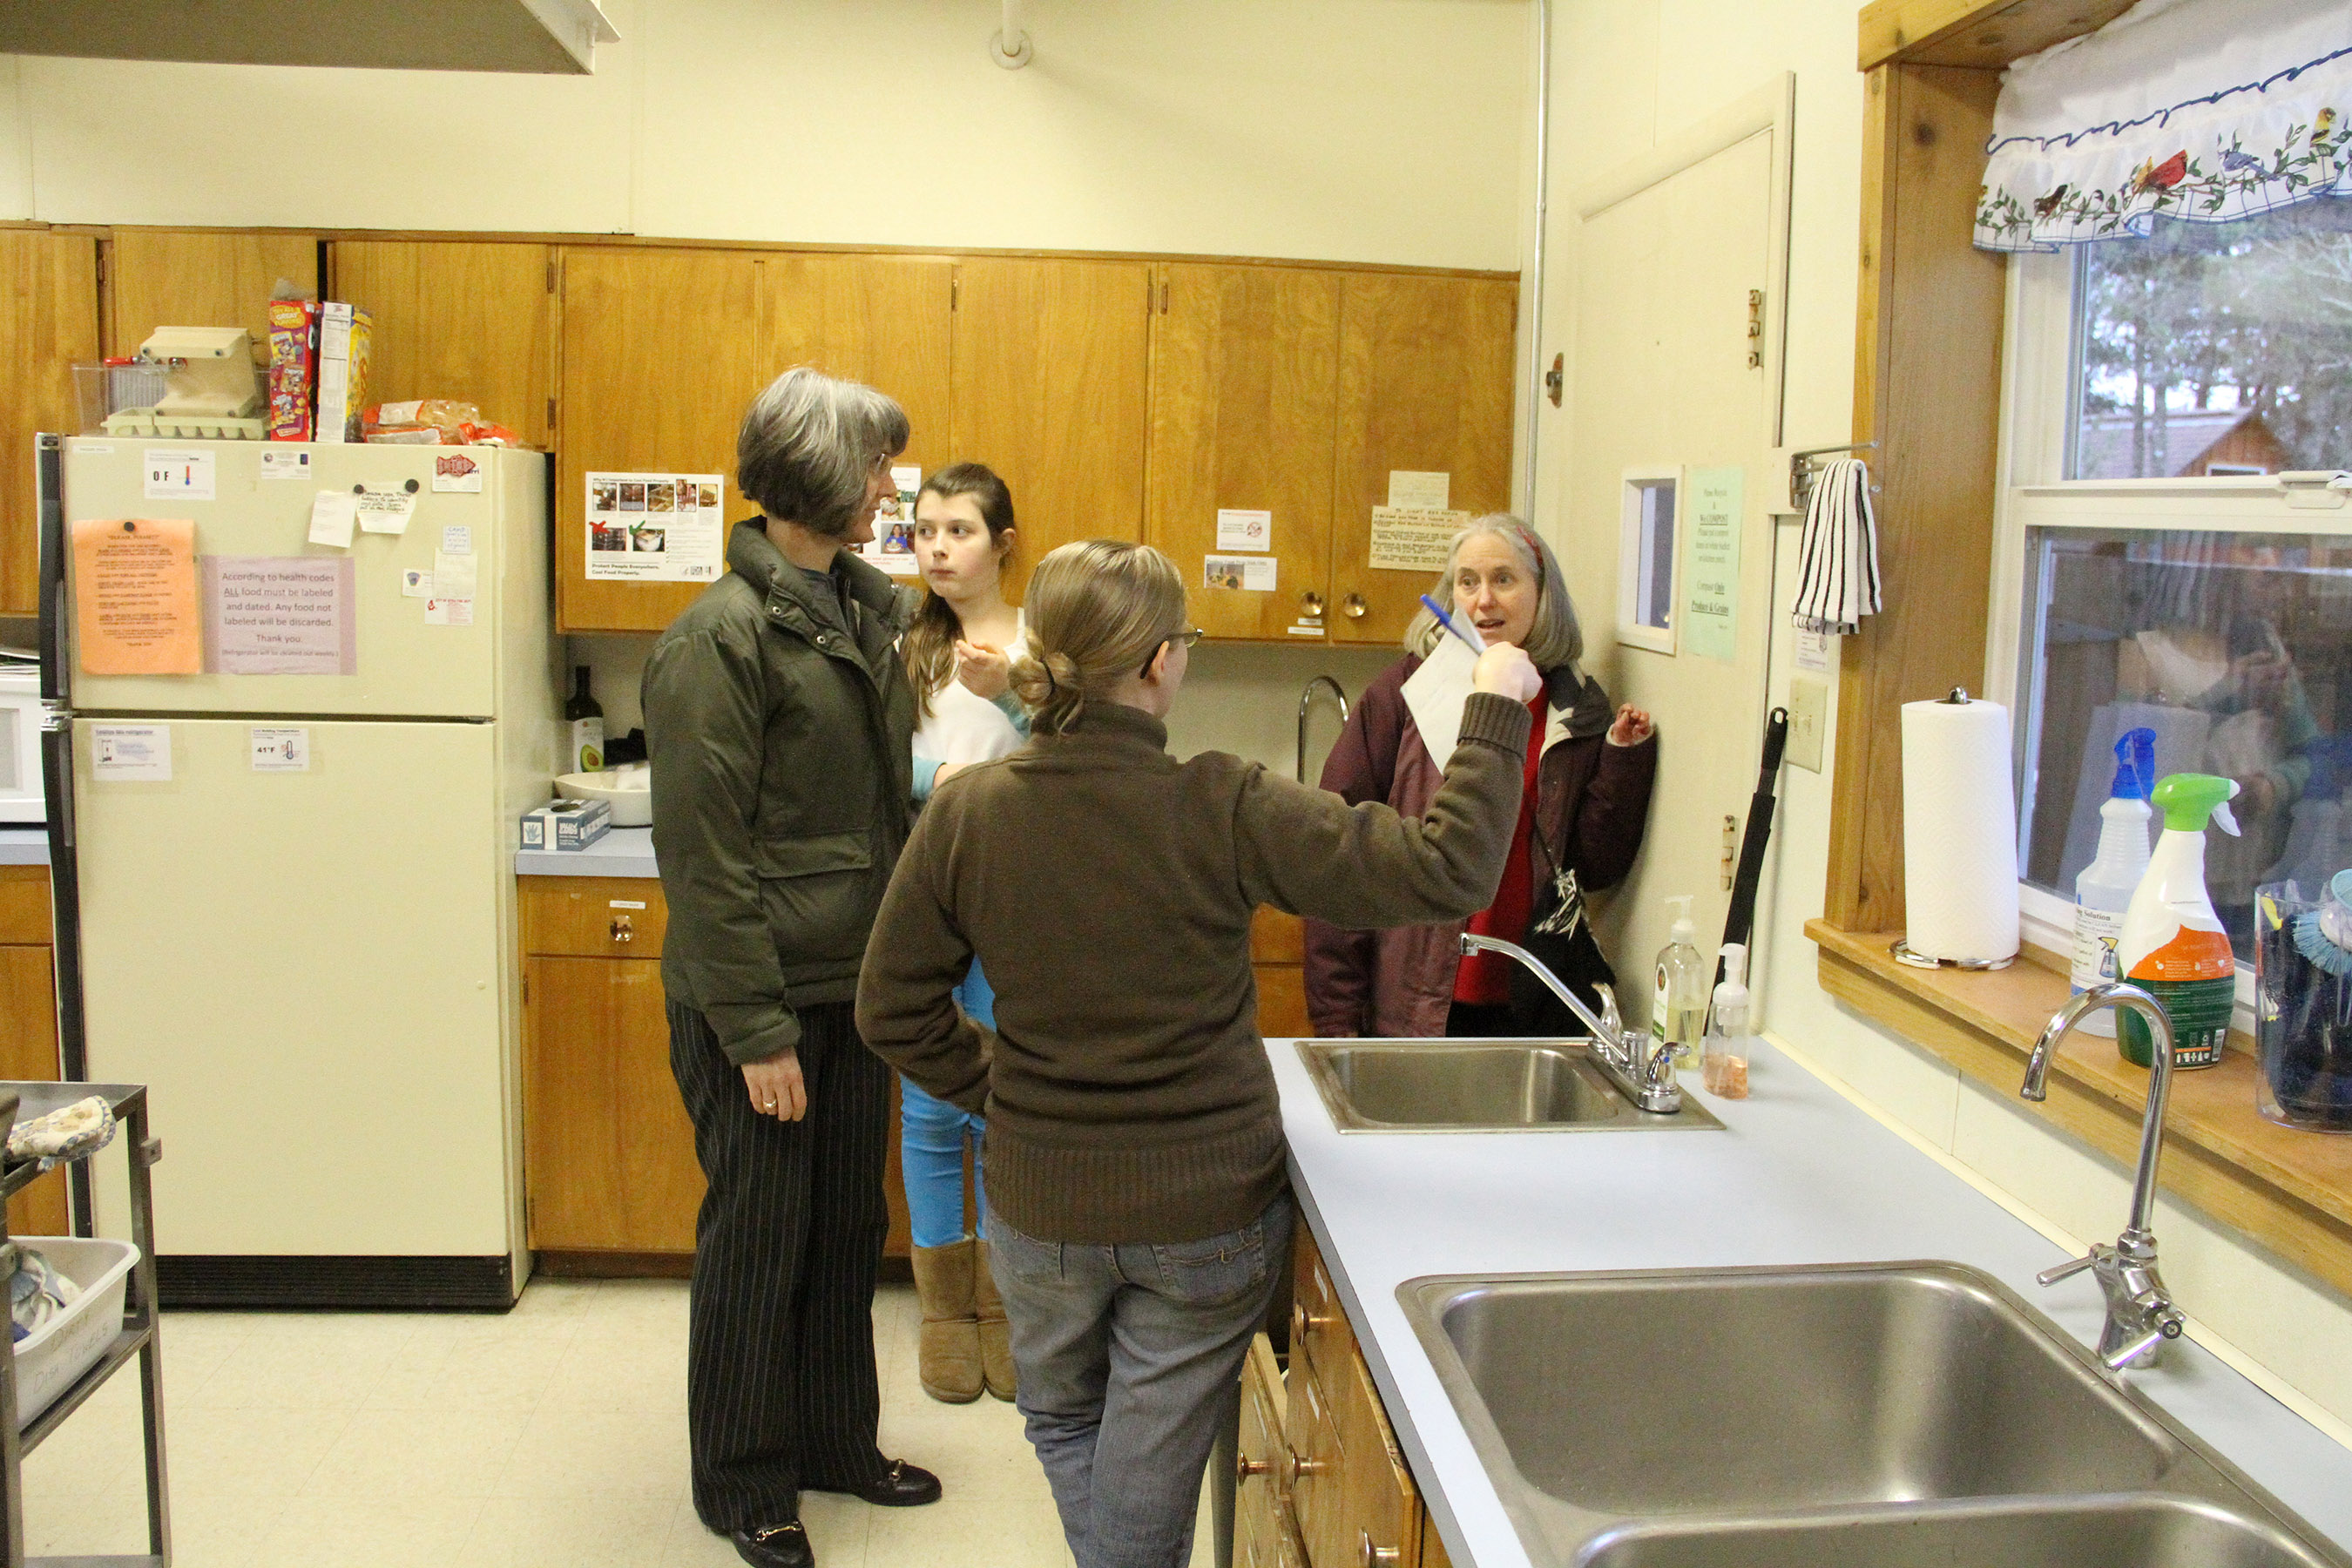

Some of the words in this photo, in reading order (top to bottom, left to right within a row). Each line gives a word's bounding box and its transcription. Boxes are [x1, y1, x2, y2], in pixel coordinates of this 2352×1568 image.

[164, 471, 169, 481] F
[1707, 514, 1728, 524] COMPOST
[222, 573, 265, 583] According
[279, 572, 308, 582] health
[309, 573, 335, 582] codes
[224, 587, 239, 598] ALL
[241, 587, 262, 597] food
[288, 588, 299, 597] be
[301, 588, 334, 597] labeled
[275, 603, 292, 612] Any
[294, 603, 314, 612] food
[316, 604, 332, 612] not
[1692, 599, 1708, 612] Produce
[225, 617, 257, 625] labeled
[259, 617, 274, 625] will
[276, 617, 287, 625] be
[289, 618, 334, 626] discarded.
[256, 634, 282, 643] Thank
[2084, 909, 2111, 922] Solution
